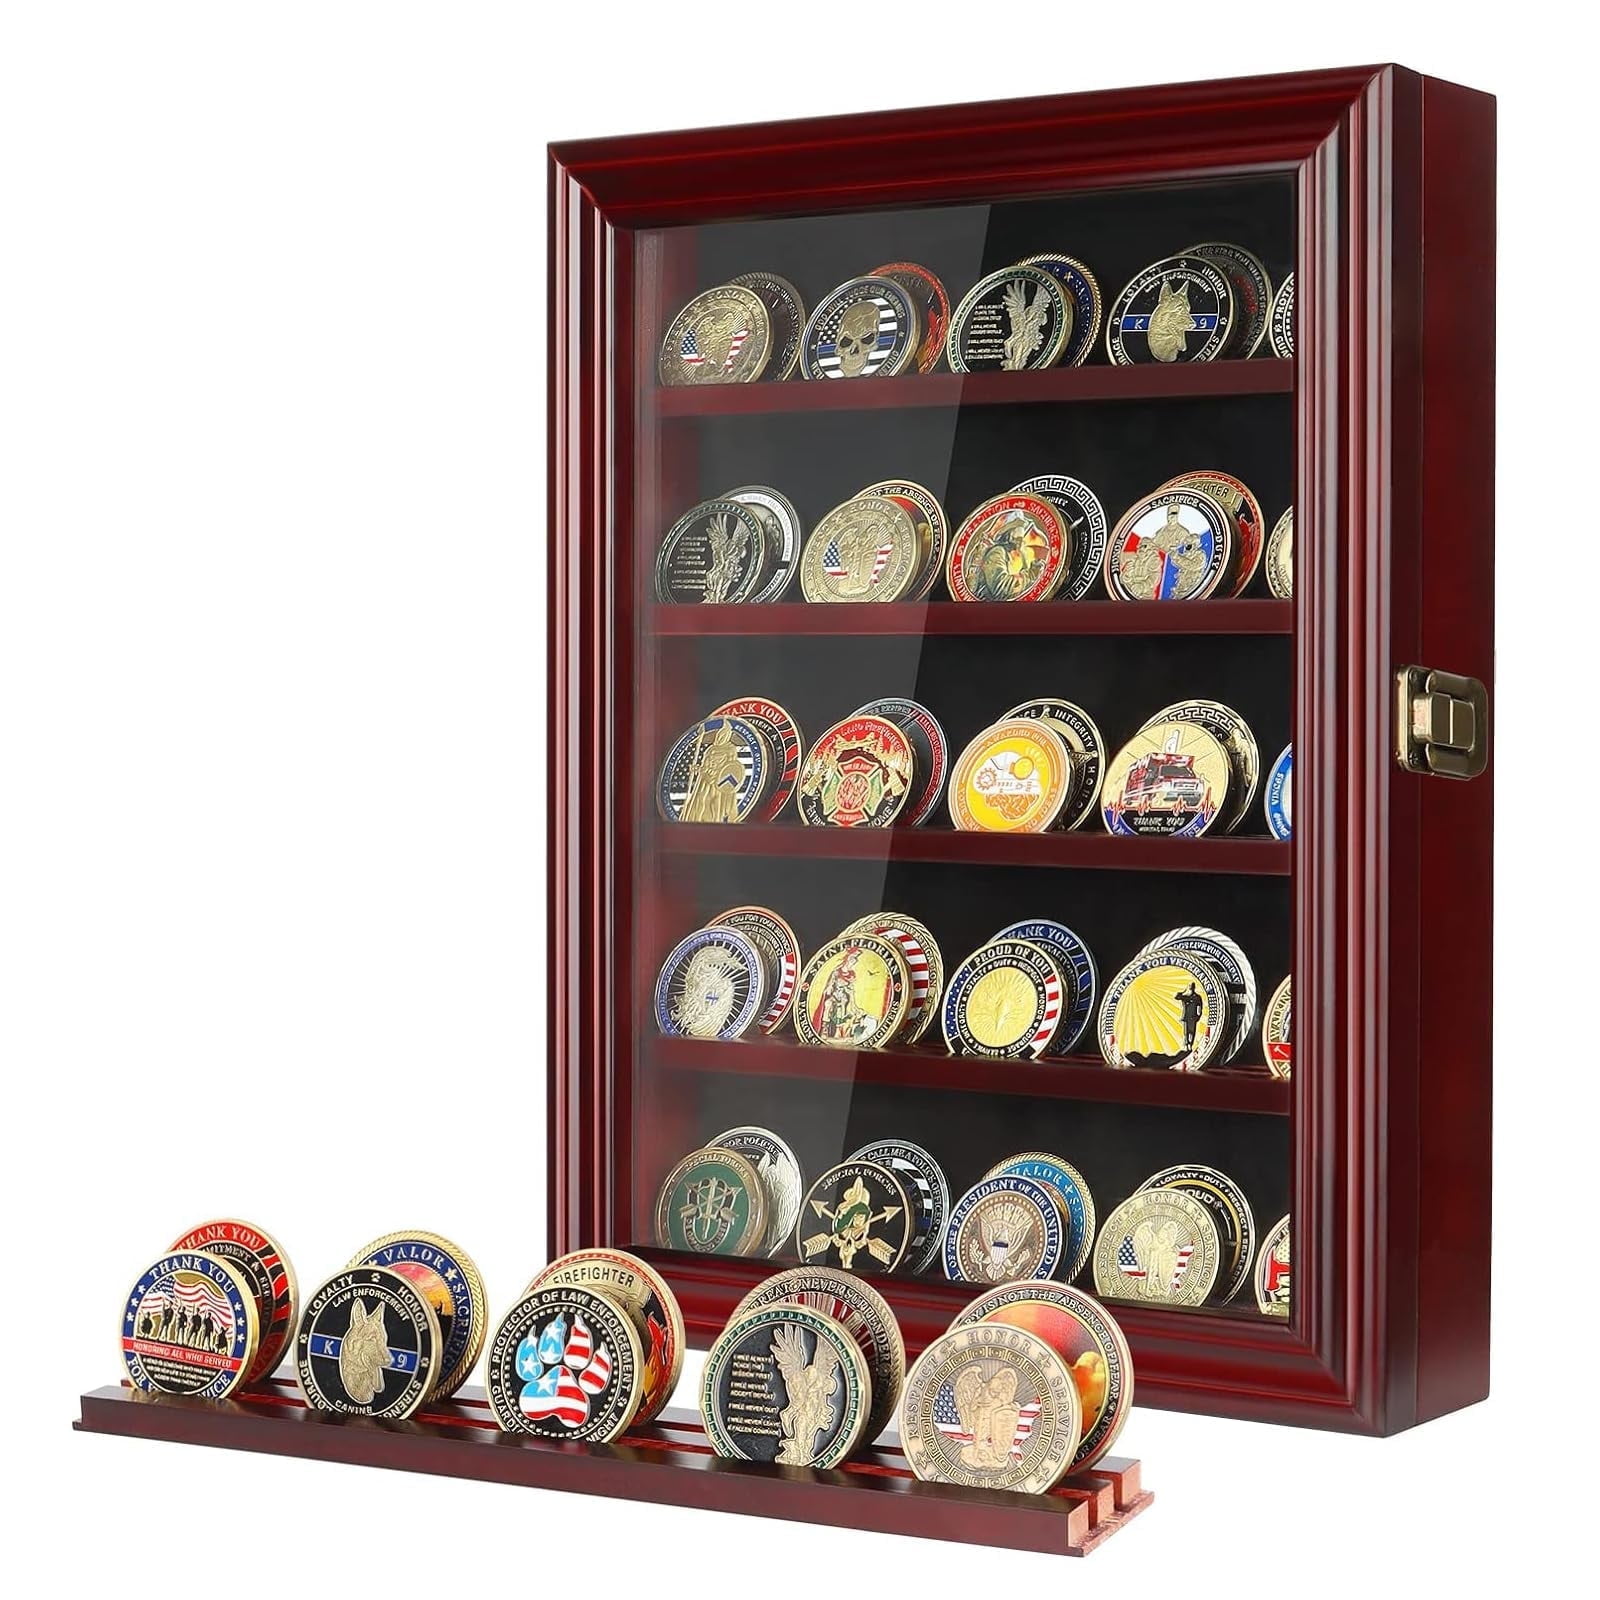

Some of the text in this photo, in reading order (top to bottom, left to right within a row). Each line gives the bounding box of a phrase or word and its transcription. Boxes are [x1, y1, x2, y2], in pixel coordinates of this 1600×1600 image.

[1202, 266, 1226, 299] HONOR
[1199, 318, 1207, 328] 9
[903, 490, 934, 514] ABSENCE
[1151, 495, 1200, 509] SACRIFICE
[963, 502, 1010, 544] TRADITION
[1212, 533, 1223, 570] DUTY
[722, 703, 783, 723] HANK YOU
[1055, 709, 1094, 748] INTEGRITY
[1048, 928, 1072, 948] YOU
[809, 940, 899, 976] SAINT FLORIAN
[974, 944, 1050, 977] PROUD OF YOU
[965, 966, 988, 994] LOYALTY
[1017, 962, 1041, 988] RESPECT
[1115, 956, 1213, 1001] THANK YOU VETERANS
[799, 1000, 813, 1039] PATRON
[1037, 993, 1045, 1022] HONOR
[1007, 1028, 1035, 1053] COURAGE
[822, 1167, 897, 1196] SPECIAL FORCES
[867, 1148, 942, 1228] CALL ME A POLICE OFFICER
[1158, 1173, 1198, 1187] LOYALTY
[1203, 1175, 1226, 1189] DUTY
[1143, 1194, 1189, 1208] HONOR
[231, 1227, 261, 1248] YOU
[948, 1228, 956, 1252] THE
[954, 1179, 1018, 1227] PRESIDENT
[1018, 1183, 1031, 1194] OF
[1031, 1188, 1046, 1210] THE
[1043, 1209, 1058, 1265] UNITED
[383, 1246, 444, 1270] VALOR
[1100, 1215, 1127, 1279] RESPECT
[1200, 1225, 1215, 1290] SERVICE
[149, 1256, 235, 1293] THANK YOU
[553, 1267, 635, 1288] FIREFIGHTER
[308, 1274, 354, 1316] LOYALTY
[332, 1288, 409, 1322] LAW ENFORCEMENT
[397, 1286, 428, 1332] HONOR
[800, 1278, 891, 1362] NEVER SURRENDER
[133, 1342, 170, 1357] HONORING
[172, 1348, 184, 1360] ALL
[185, 1351, 202, 1363] WHO
[203, 1355, 232, 1368] SERVED
[323, 1341, 333, 1355] K
[492, 1290, 633, 1393] PROTECTOR OF LAW ENFORCEMENT
[965, 1329, 1032, 1352] HONOR
[984, 1290, 1121, 1400] IS NOT THE ABSENCE OF FEAR
[127, 1359, 147, 1384] FOR
[398, 1355, 408, 1368] 9
[378, 1380, 422, 1418] STRENG
[907, 1355, 943, 1440] RESPECT
[1049, 1375, 1069, 1463] SERVICE
